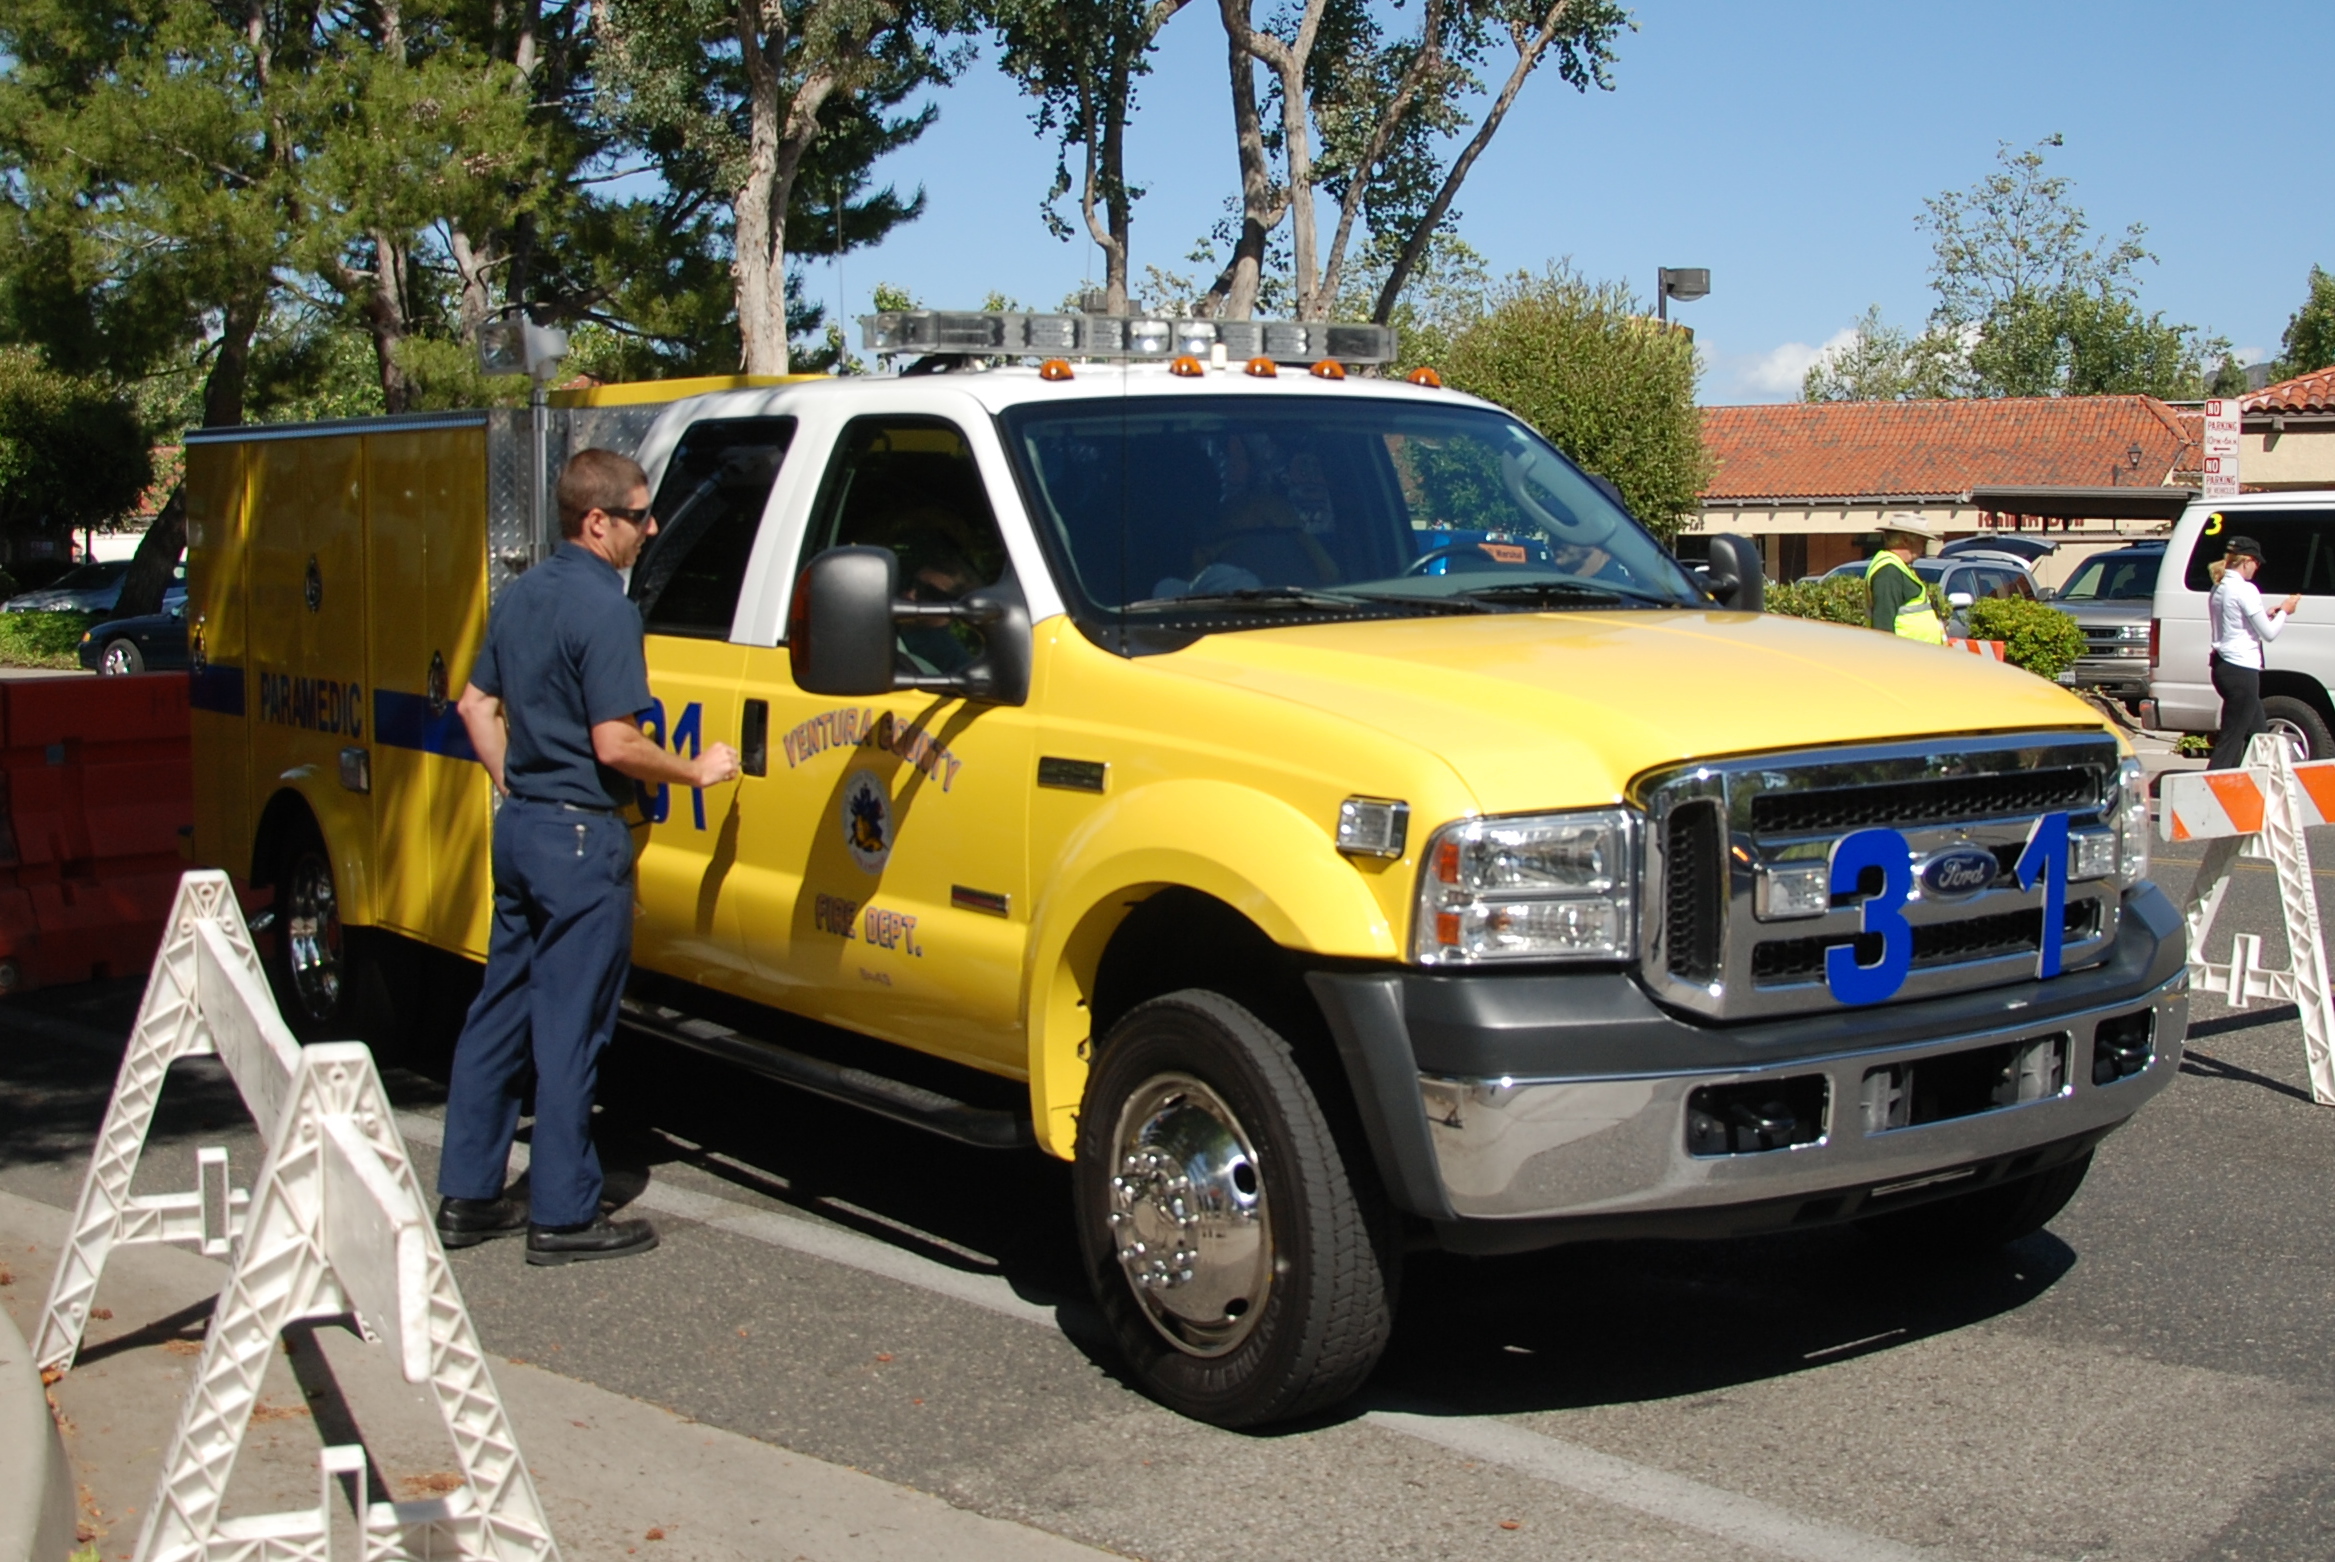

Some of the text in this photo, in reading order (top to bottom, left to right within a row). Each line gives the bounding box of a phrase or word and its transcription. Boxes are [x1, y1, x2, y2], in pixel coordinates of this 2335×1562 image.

[2207, 402, 2220, 415] NO
[2207, 421, 2238, 431] PARKING
[2206, 459, 2219, 472] NO
[2206, 475, 2236, 485] PARKING
[2205, 513, 2223, 535] 3
[260, 671, 362, 739] PARAMEDIC
[782, 707, 874, 769] VENTURA
[878, 710, 963, 793] COUNTY
[1938, 857, 1986, 888] Ford
[815, 893, 923, 958] FIRE DEPT.
